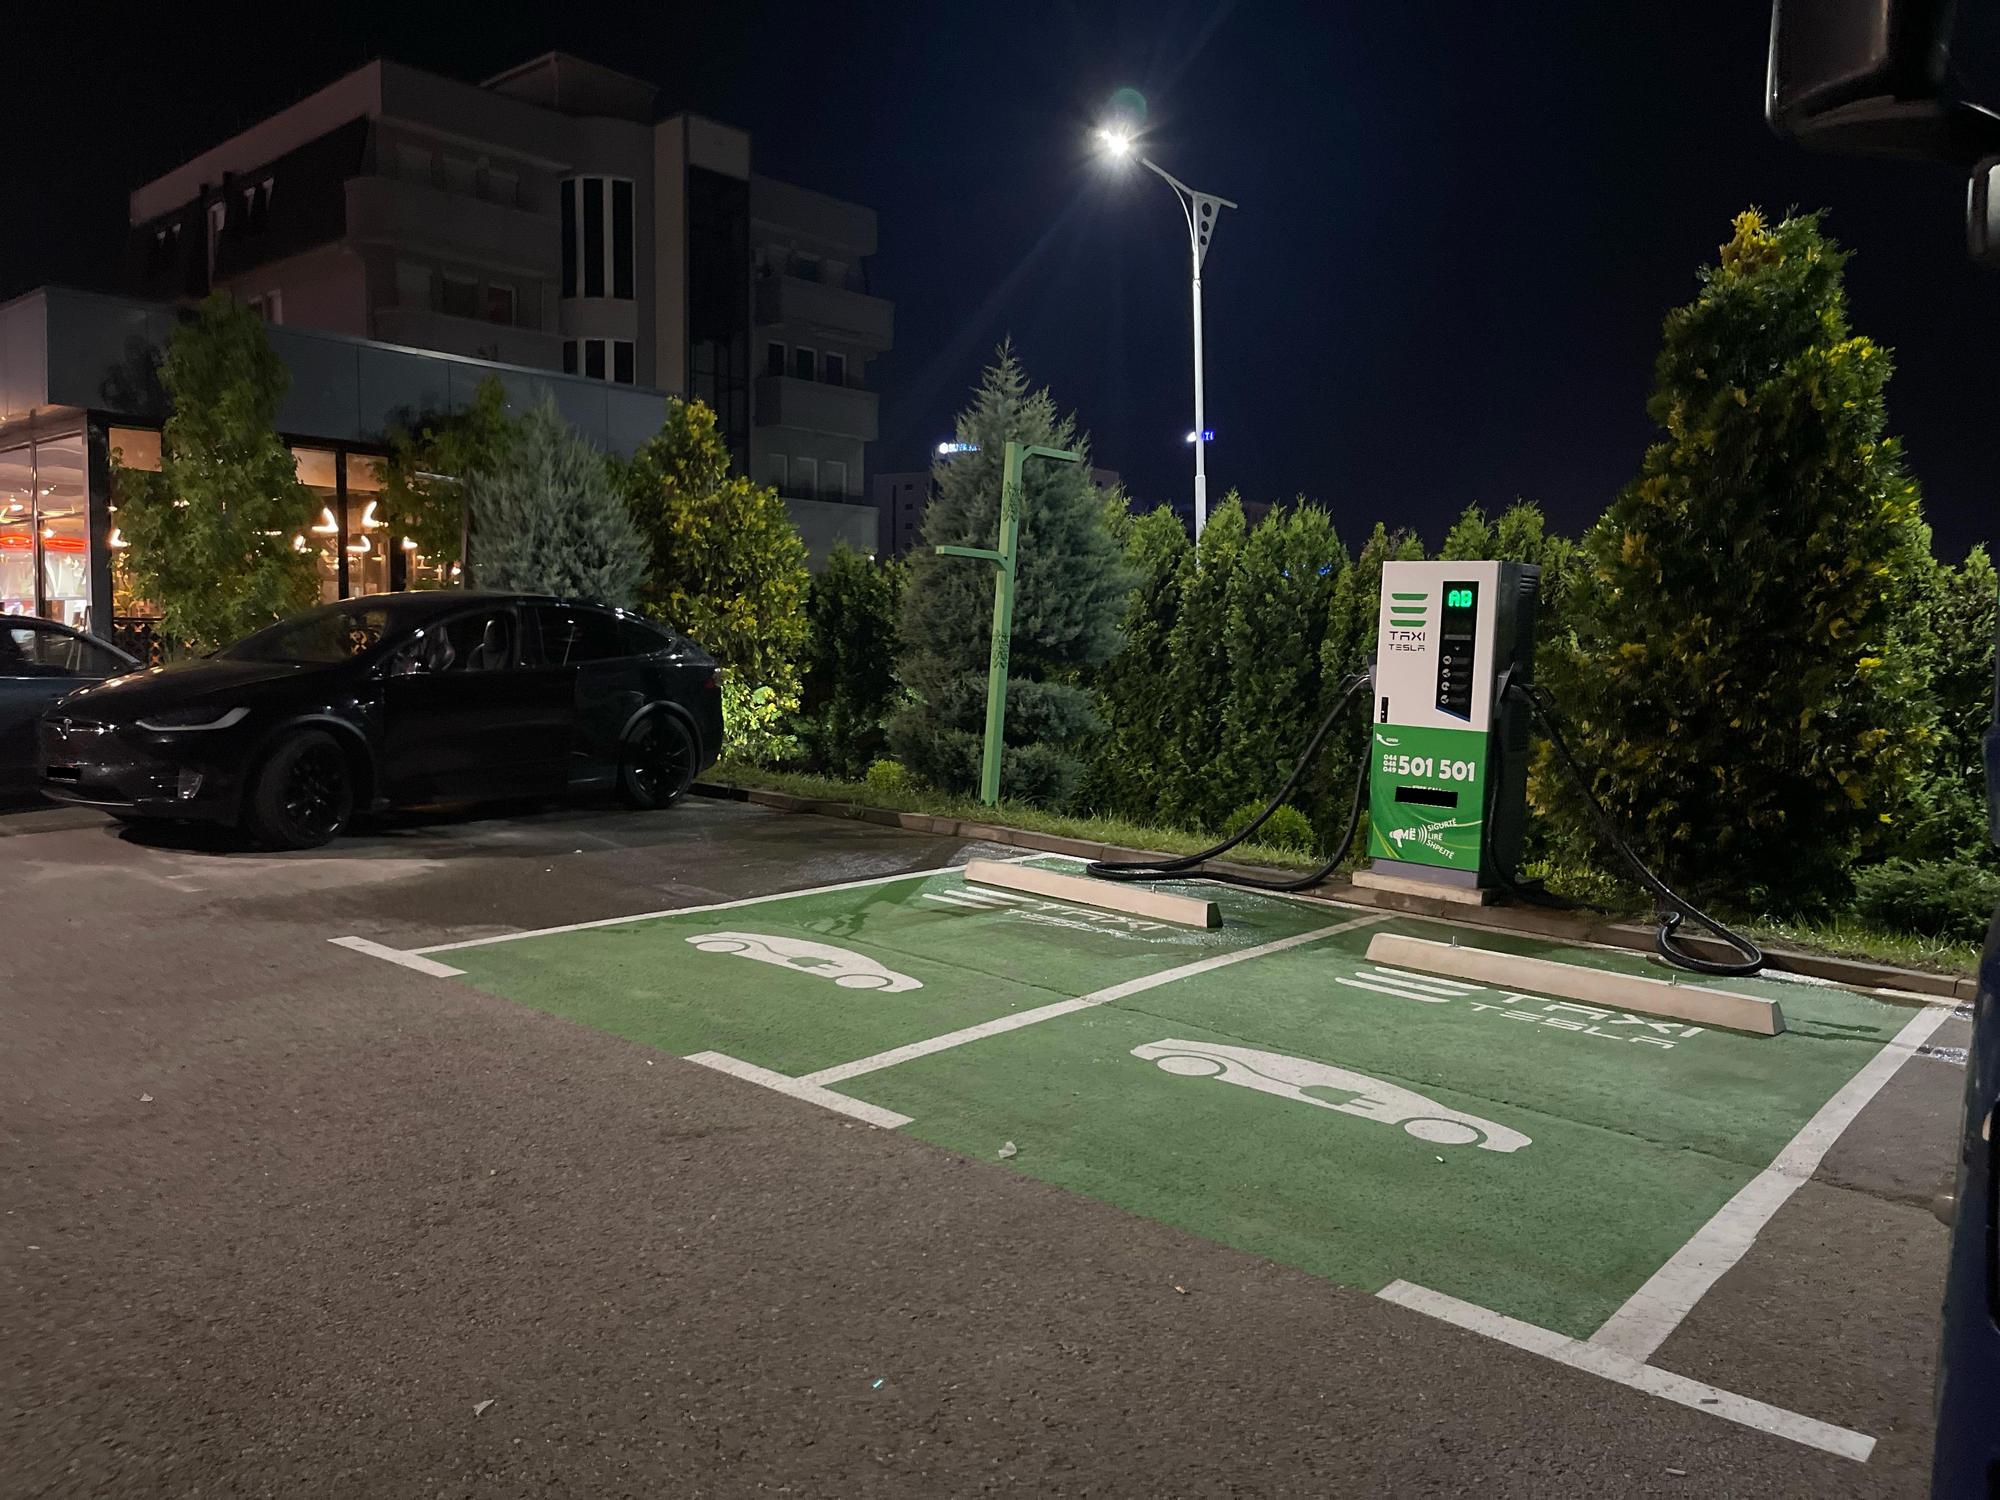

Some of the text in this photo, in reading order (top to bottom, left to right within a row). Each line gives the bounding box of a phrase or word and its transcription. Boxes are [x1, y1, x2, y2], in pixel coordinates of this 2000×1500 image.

[1448, 590, 1472, 607] AB
[1389, 631, 1426, 641] TAXI
[1388, 643, 1425, 651] TESLA
[1398, 755, 1476, 782] 501 501
[1427, 817, 1456, 832] SIGURTË
[1426, 839, 1455, 860] SHPEJTË
[1498, 990, 1706, 1037] TAXI
[1470, 1002, 1679, 1049] TESLA
